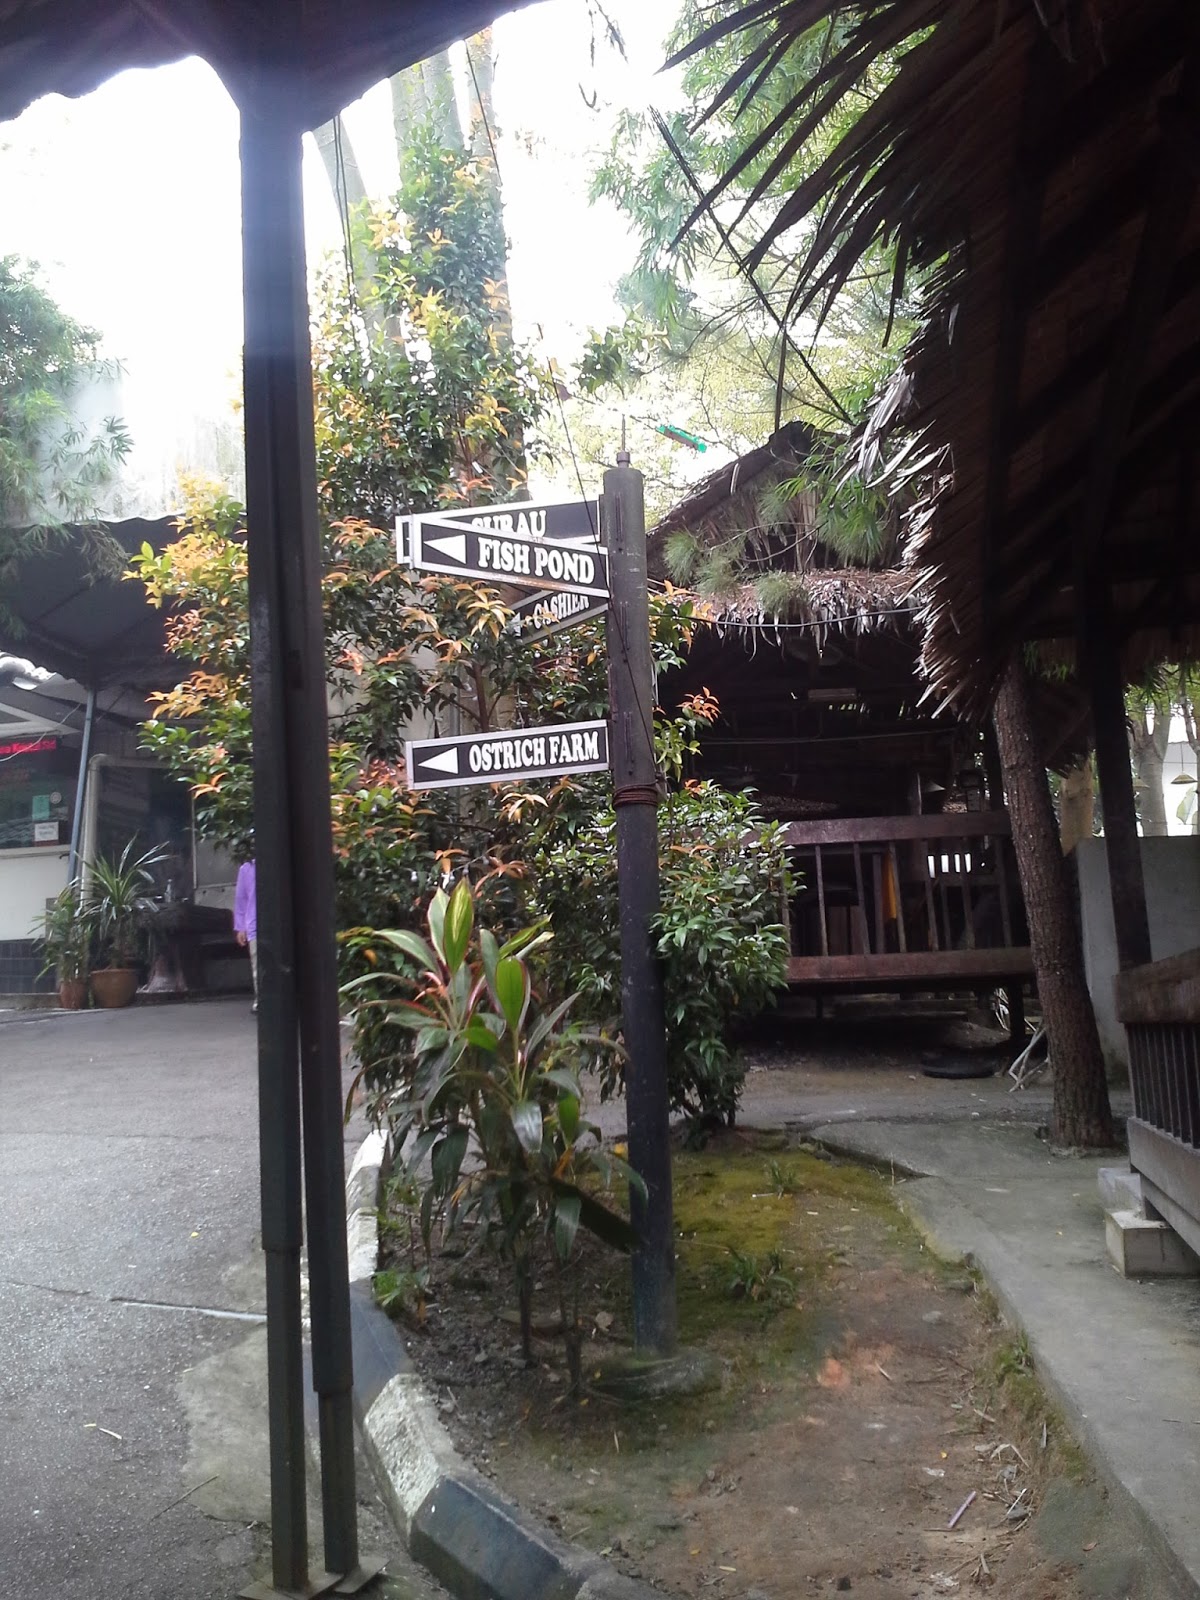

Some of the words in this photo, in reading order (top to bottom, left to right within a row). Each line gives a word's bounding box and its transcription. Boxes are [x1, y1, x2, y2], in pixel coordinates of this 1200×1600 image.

[477, 537, 530, 574] FISH
[534, 547, 595, 584] POND
[469, 737, 545, 772] OSTRICH
[549, 731, 599, 764] FARM
